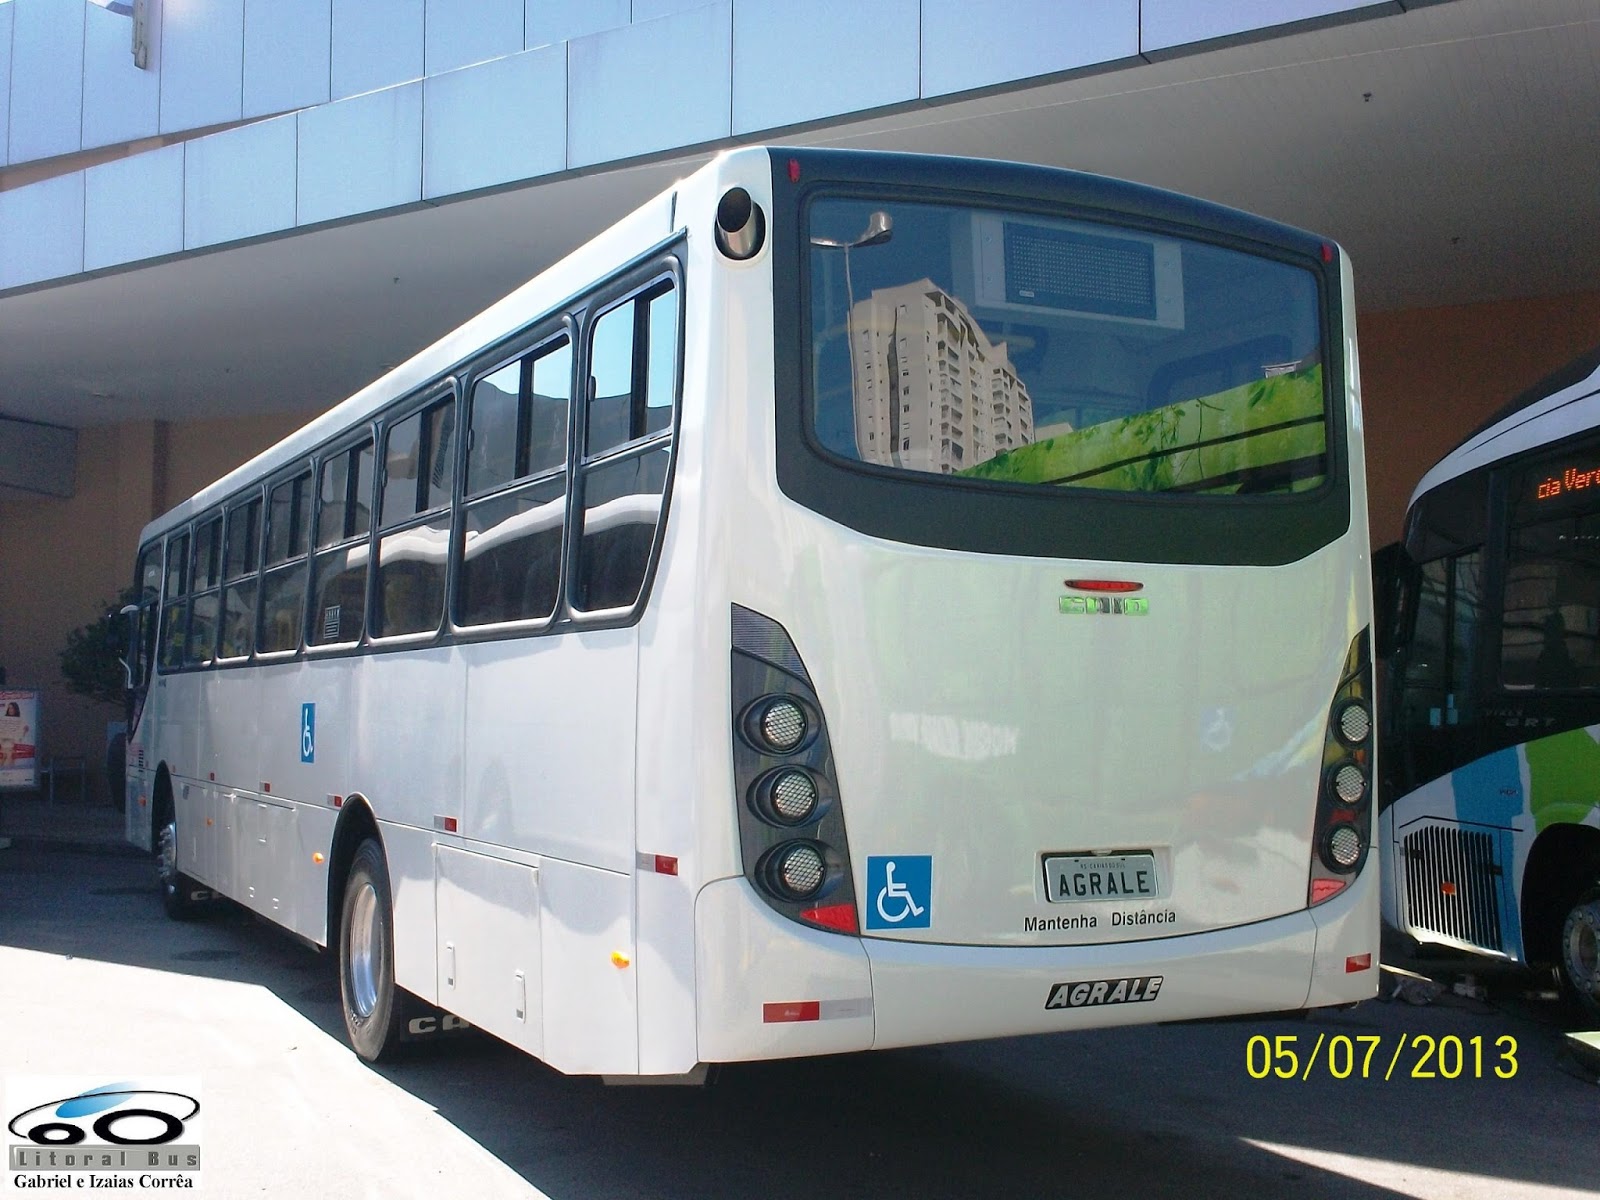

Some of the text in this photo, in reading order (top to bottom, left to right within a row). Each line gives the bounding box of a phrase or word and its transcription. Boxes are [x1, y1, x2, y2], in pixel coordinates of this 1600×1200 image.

[1538, 477, 1561, 499] cia
[1059, 870, 1150, 897] AGRALE
[1024, 909, 1176, 932] Mantenha Distância
[1048, 977, 1163, 1008] AGRALE
